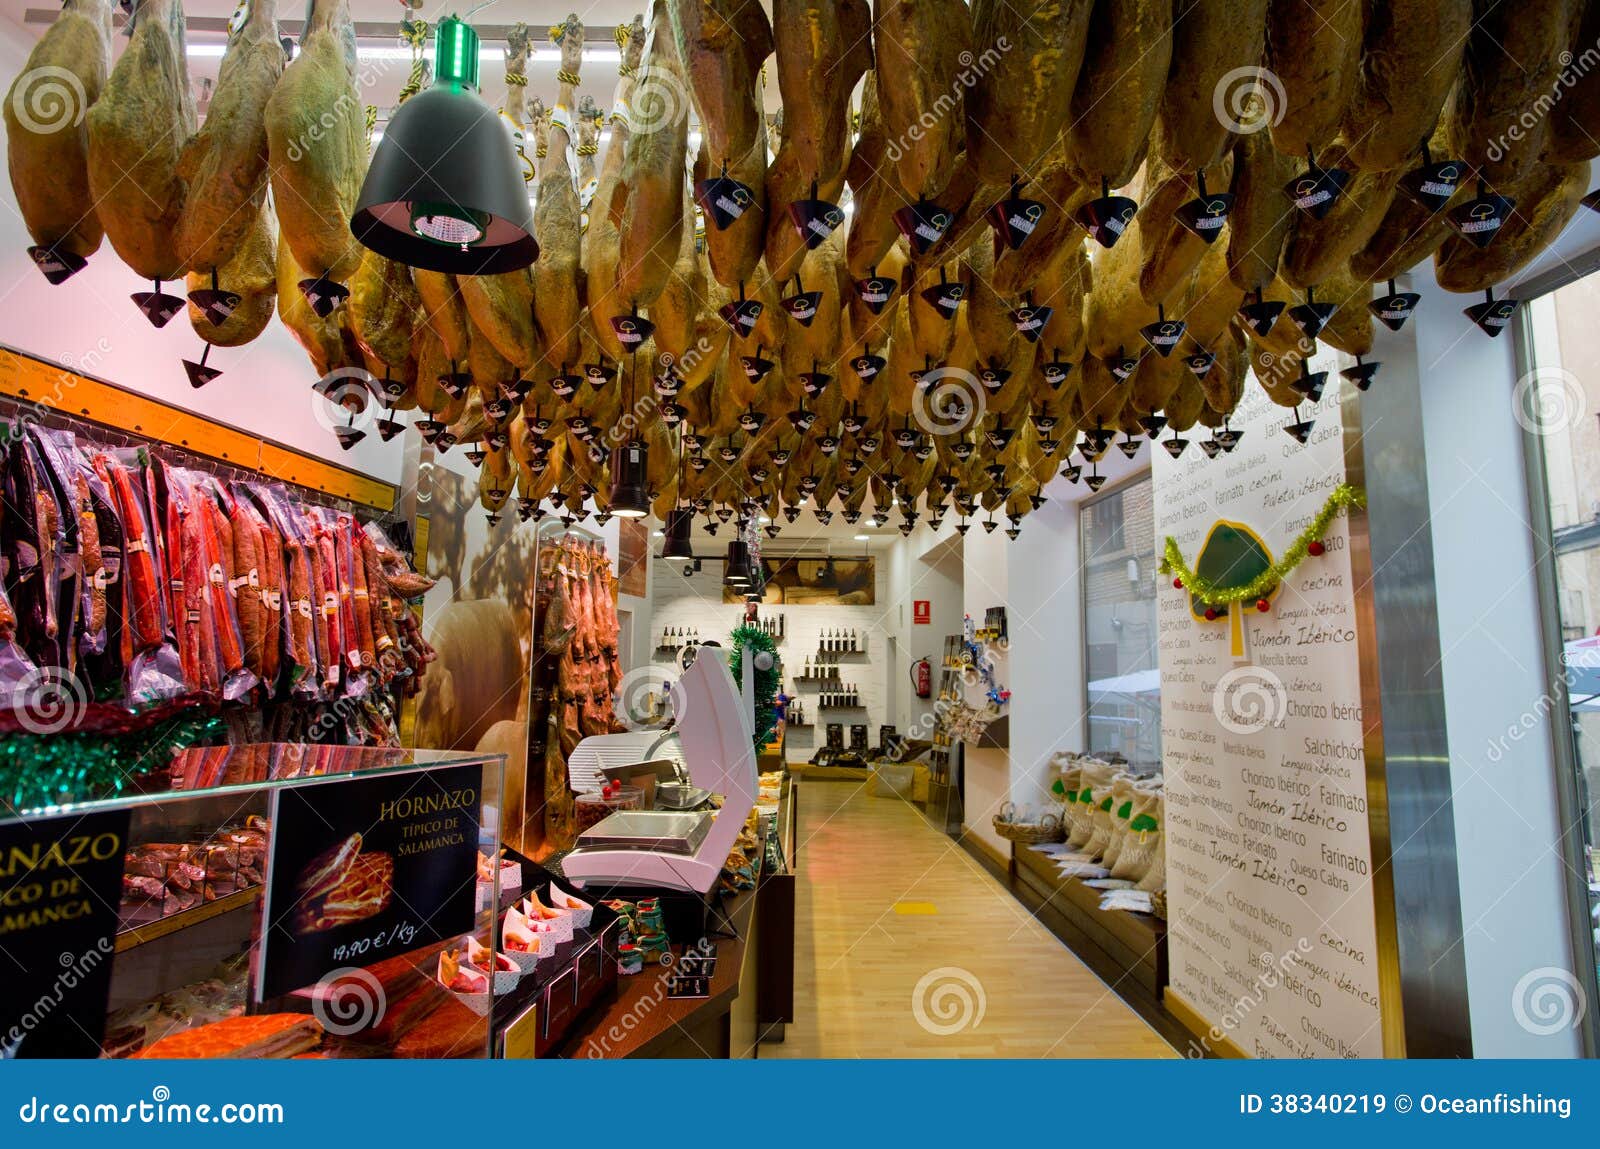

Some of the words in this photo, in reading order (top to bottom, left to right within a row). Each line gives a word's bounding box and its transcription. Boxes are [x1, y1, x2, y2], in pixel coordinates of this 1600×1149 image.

[1310, 425, 1340, 445] Cabra
[1250, 470, 1283, 492] cecina
[1301, 572, 1343, 592] cecina
[1277, 607, 1309, 625] Lengua
[1311, 601, 1347, 618] ibérica
[1252, 628, 1291, 648] Jamón
[1297, 624, 1355, 646] Ibérico
[1287, 699, 1328, 719] Chorizo
[1280, 754, 1312, 775] Lengua
[380, 788, 476, 822] HORNAZO
[1241, 768, 1275, 790] Chorizo
[1278, 775, 1311, 798] Ibérico
[1320, 785, 1366, 813] Farinato
[444, 816, 460, 830] DE
[1248, 789, 1285, 815] Jamón
[1291, 801, 1348, 832] Ibérico
[398, 832, 465, 857] SALAMANCA
[1238, 812, 1272, 836] Chorizo
[1274, 823, 1307, 847] Ibérico
[1243, 833, 1277, 861] Farinato
[1321, 843, 1368, 876] Farinato
[1209, 840, 1247, 872] Jamón
[1253, 859, 1308, 896] Ibérico
[1290, 858, 1318, 881] Queso
[1319, 869, 1349, 892] Cabra
[1226, 891, 1259, 920] Chorizo
[1261, 906, 1292, 937] Ibérico
[1319, 933, 1366, 966] cecina
[1334, 972, 1379, 1010] ibérica
[1301, 1016, 1336, 1051] Chorizo
